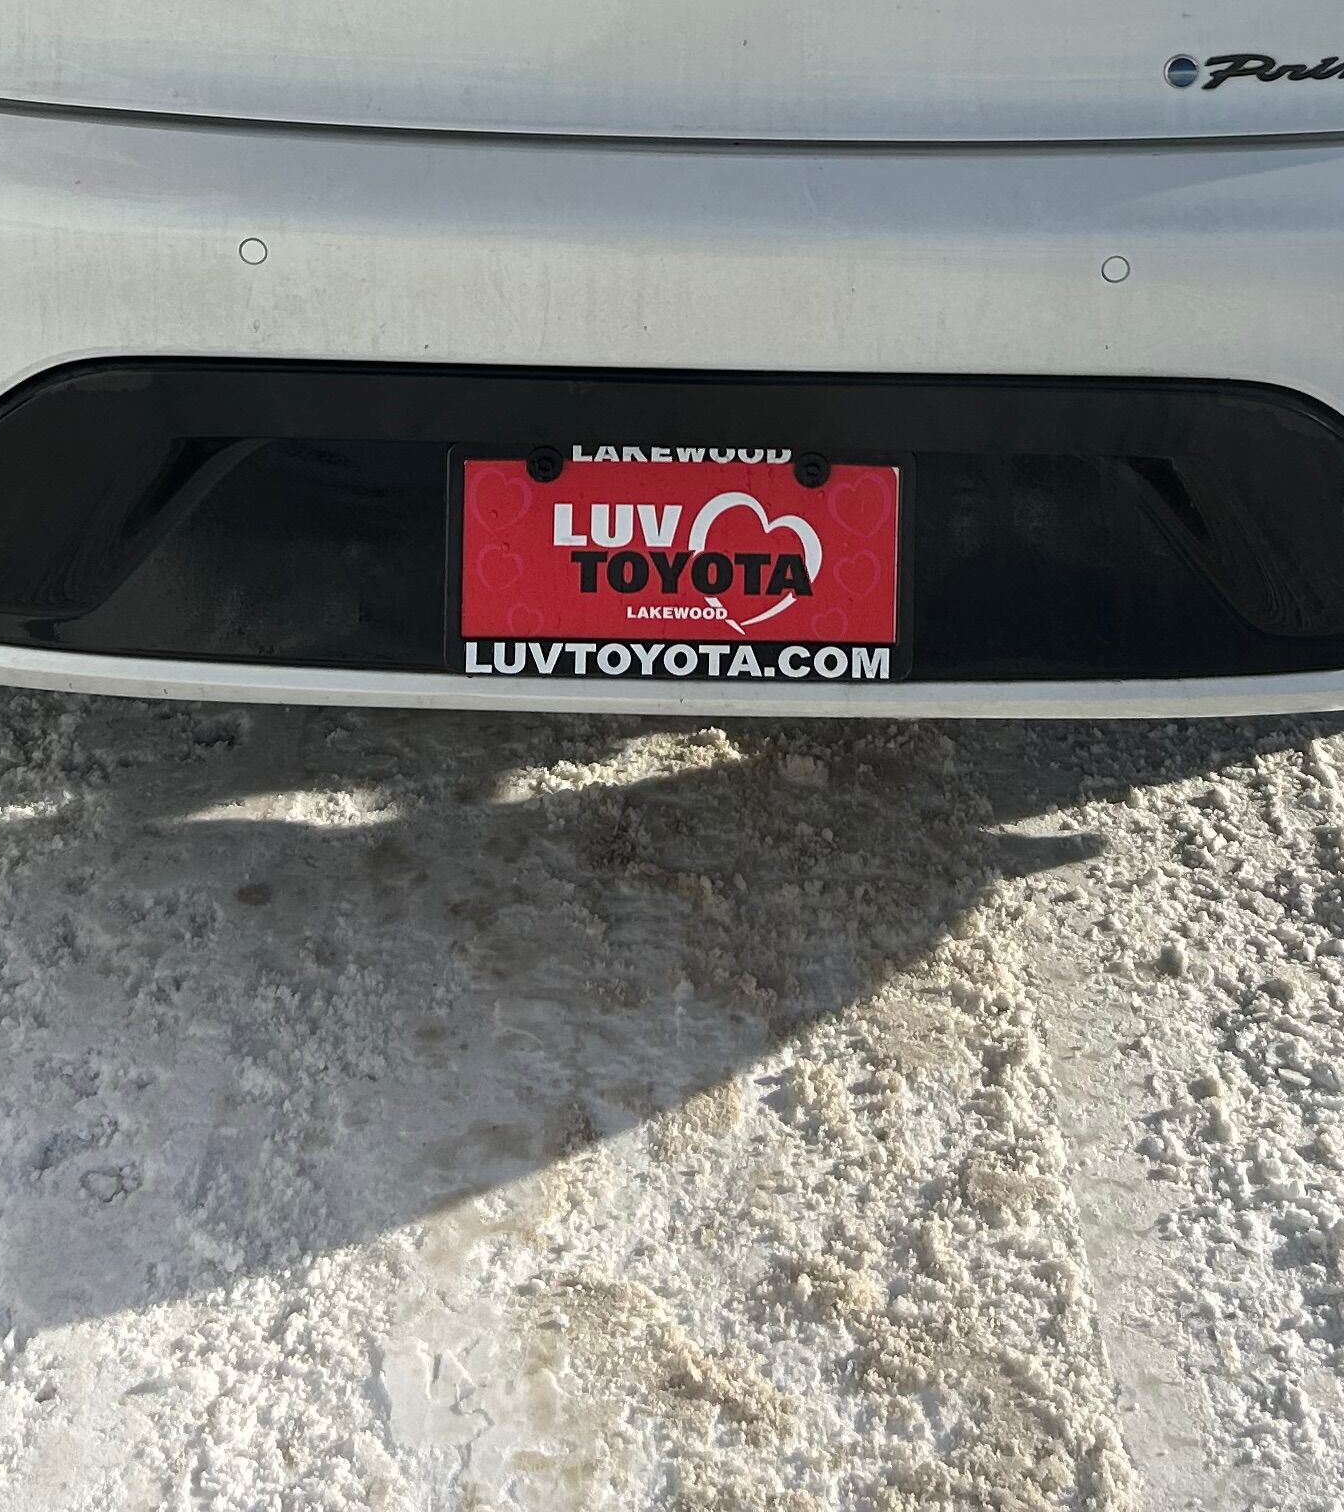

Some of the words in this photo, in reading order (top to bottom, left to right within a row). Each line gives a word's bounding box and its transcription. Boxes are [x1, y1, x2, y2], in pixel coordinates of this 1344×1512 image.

[553, 502, 683, 548] LUV
[571, 550, 814, 597] TOYOTA
[626, 605, 729, 621] LAKEWOOD
[464, 641, 891, 680] LUVTOYOTA.COM
